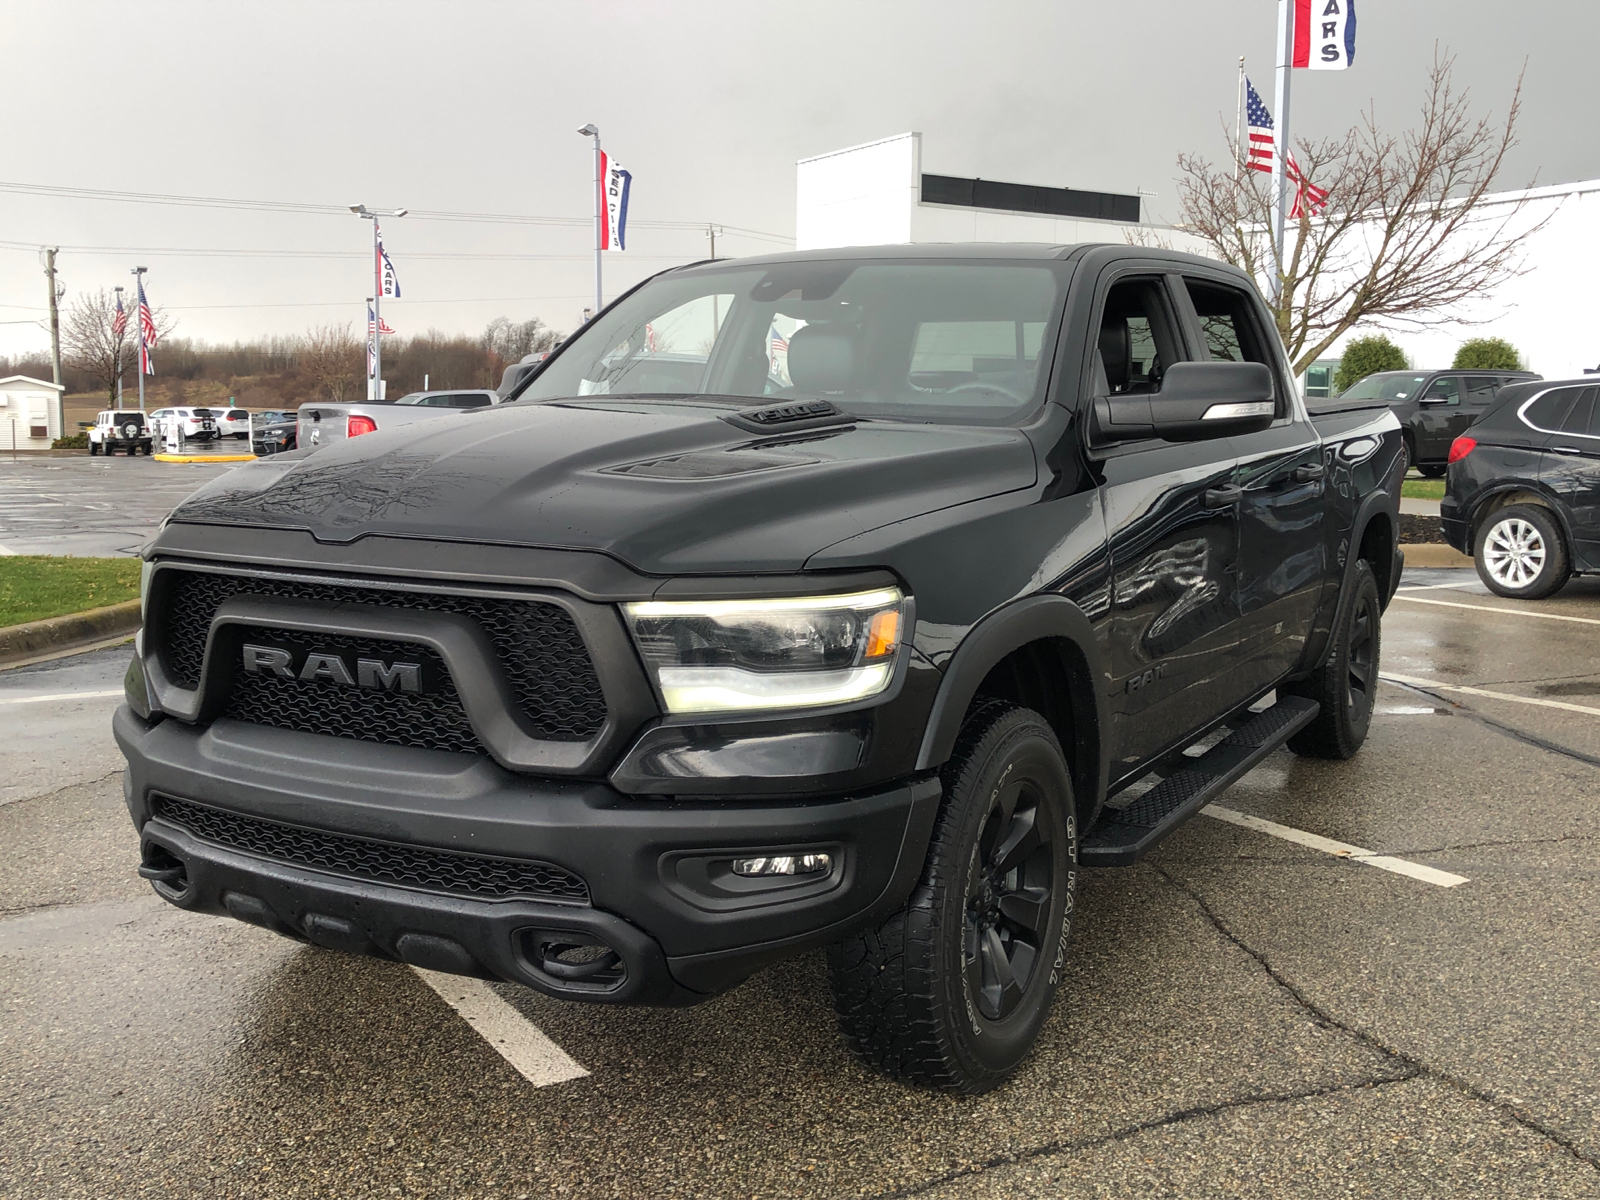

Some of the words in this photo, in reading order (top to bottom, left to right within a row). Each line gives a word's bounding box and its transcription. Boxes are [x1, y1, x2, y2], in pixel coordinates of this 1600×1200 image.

[384, 263, 393, 295] CARS
[754, 405, 811, 421] 1500
[242, 643, 422, 695] RAM
[1048, 870, 1078, 986] RADIAL
